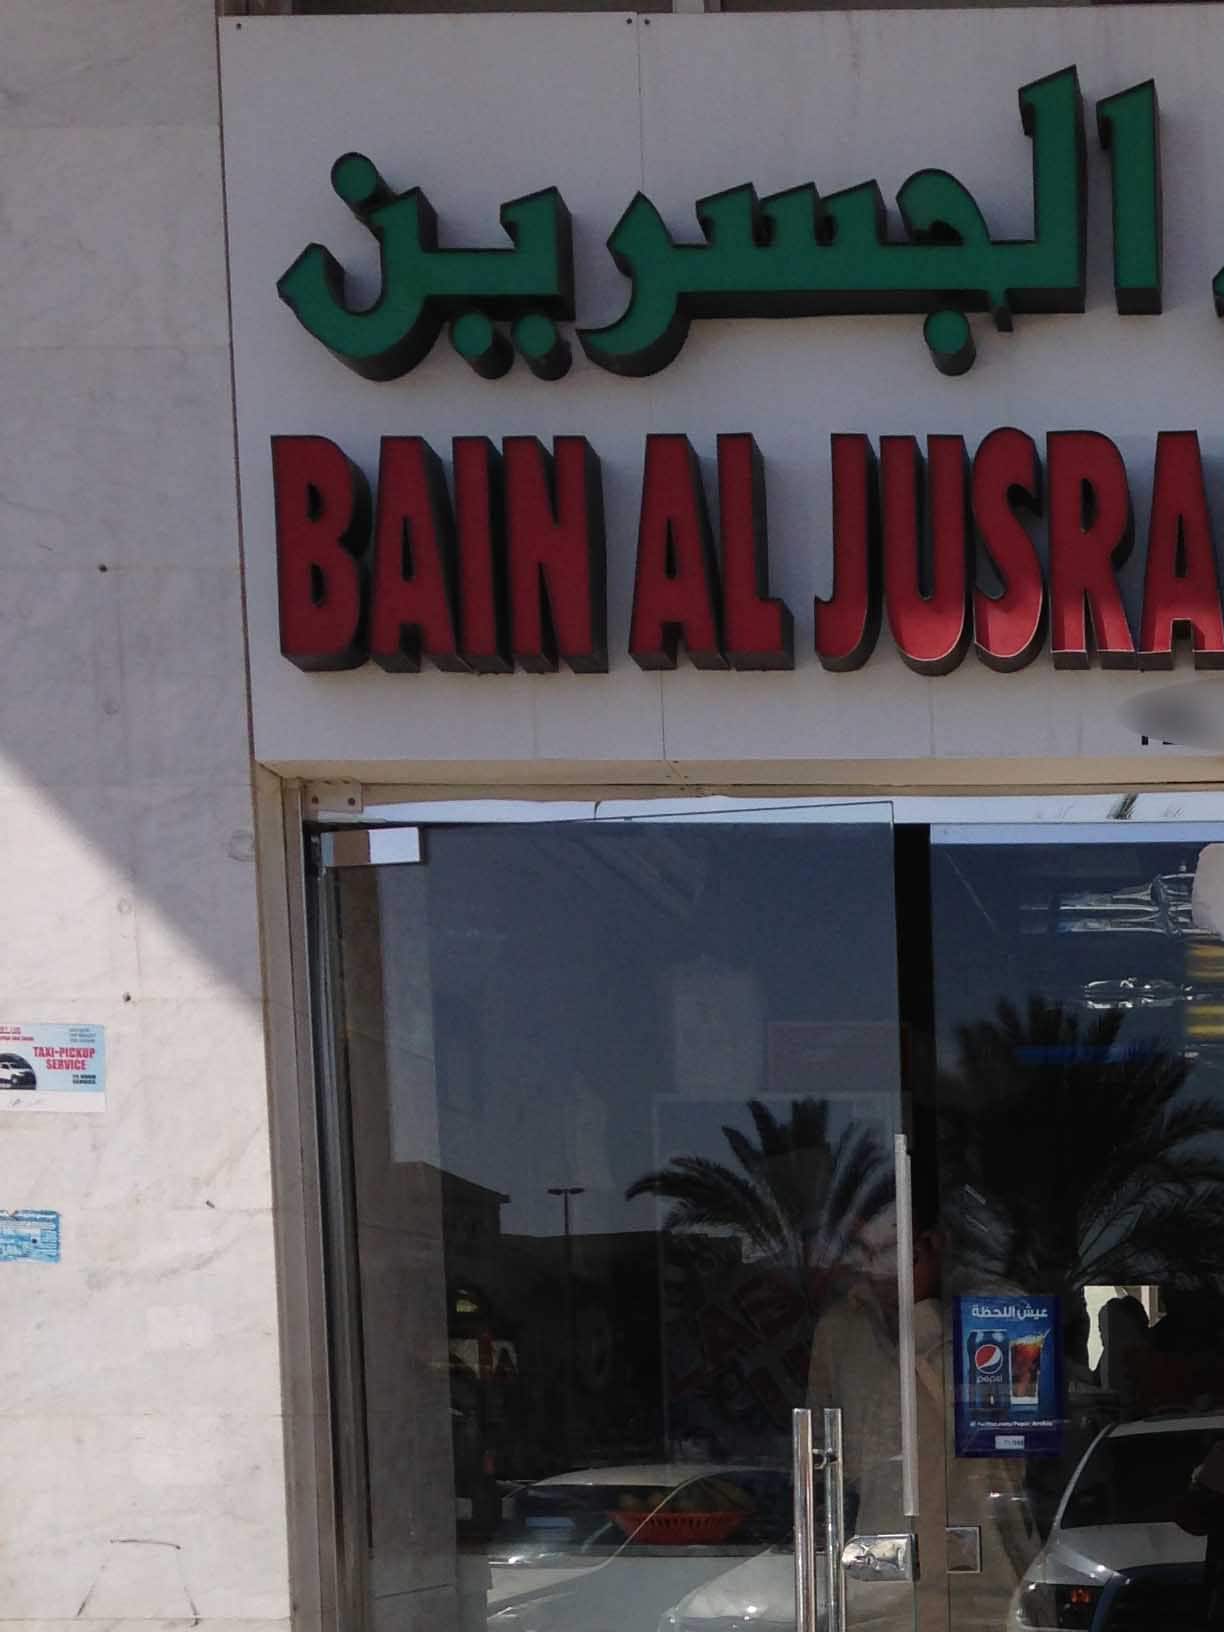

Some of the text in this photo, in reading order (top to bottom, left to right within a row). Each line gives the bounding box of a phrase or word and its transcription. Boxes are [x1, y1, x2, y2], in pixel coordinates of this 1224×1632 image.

[277, 64, 1162, 381] الجسرين
[270, 434, 608, 674] BAIN
[628, 432, 794, 671] AL
[32, 1047, 95, 1058] TAXI-PICKUP
[46, 1059, 86, 1070] SERVICE
